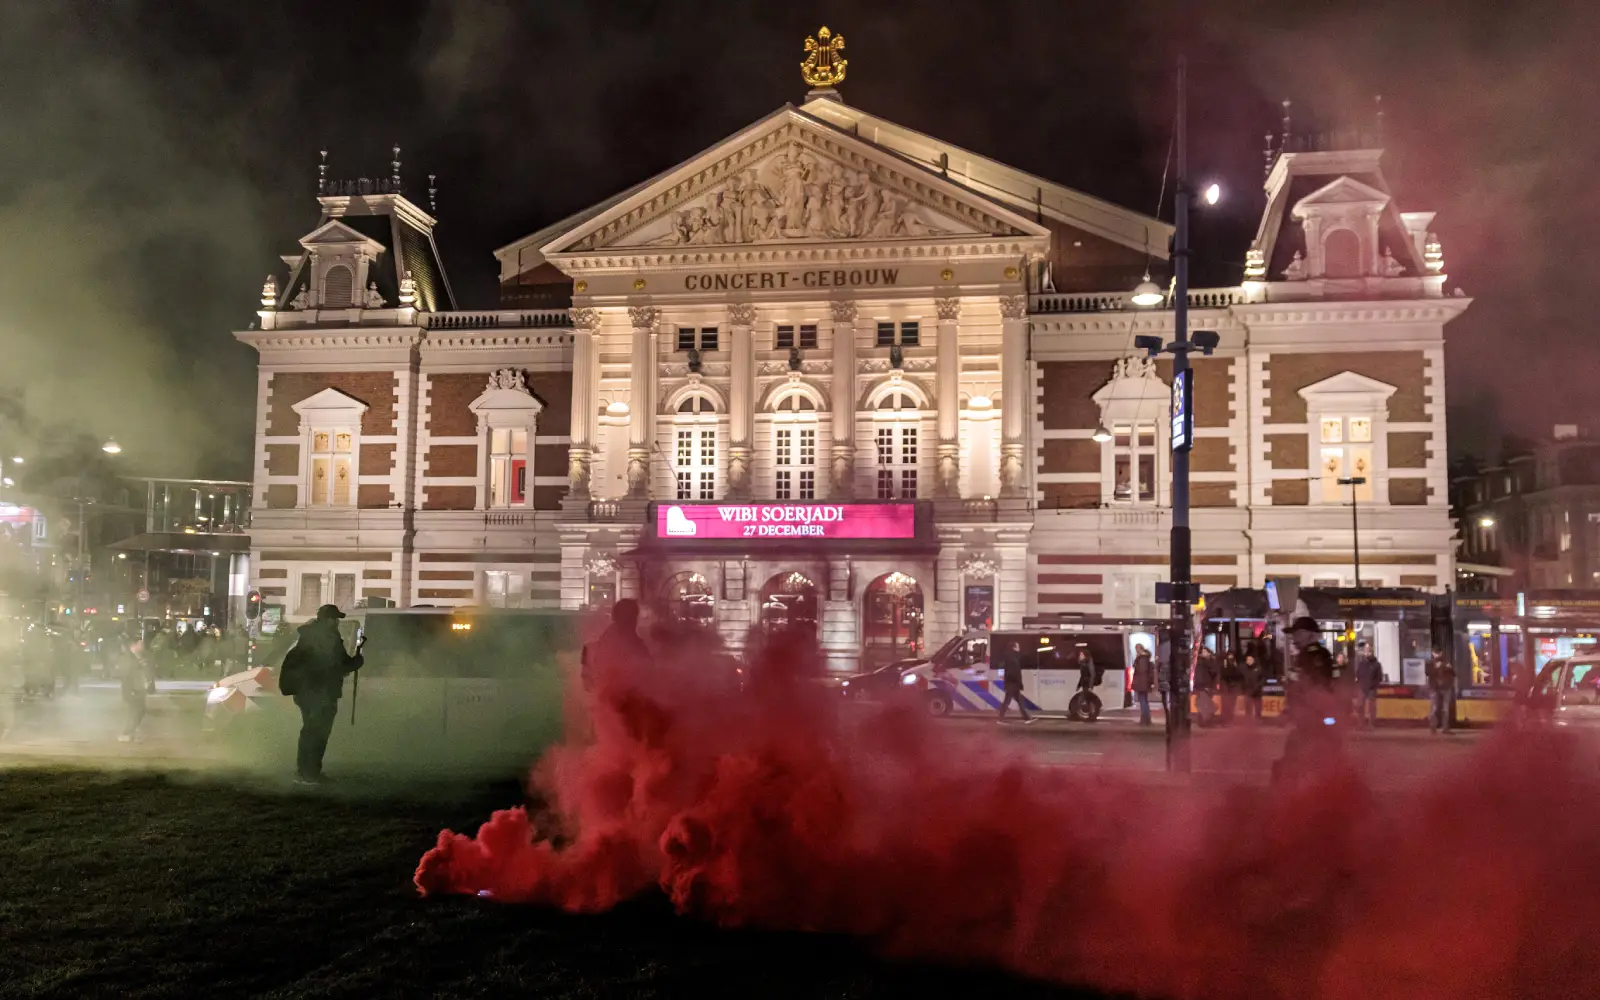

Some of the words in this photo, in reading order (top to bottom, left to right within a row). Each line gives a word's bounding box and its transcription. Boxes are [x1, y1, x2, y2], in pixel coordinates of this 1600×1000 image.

[685, 268, 899, 290] CONCERT-GEBOUW
[718, 507, 757, 522] WIBI
[761, 507, 843, 524] SOERJADI
[743, 525, 755, 536] 27
[758, 525, 824, 536] DECEMBER
